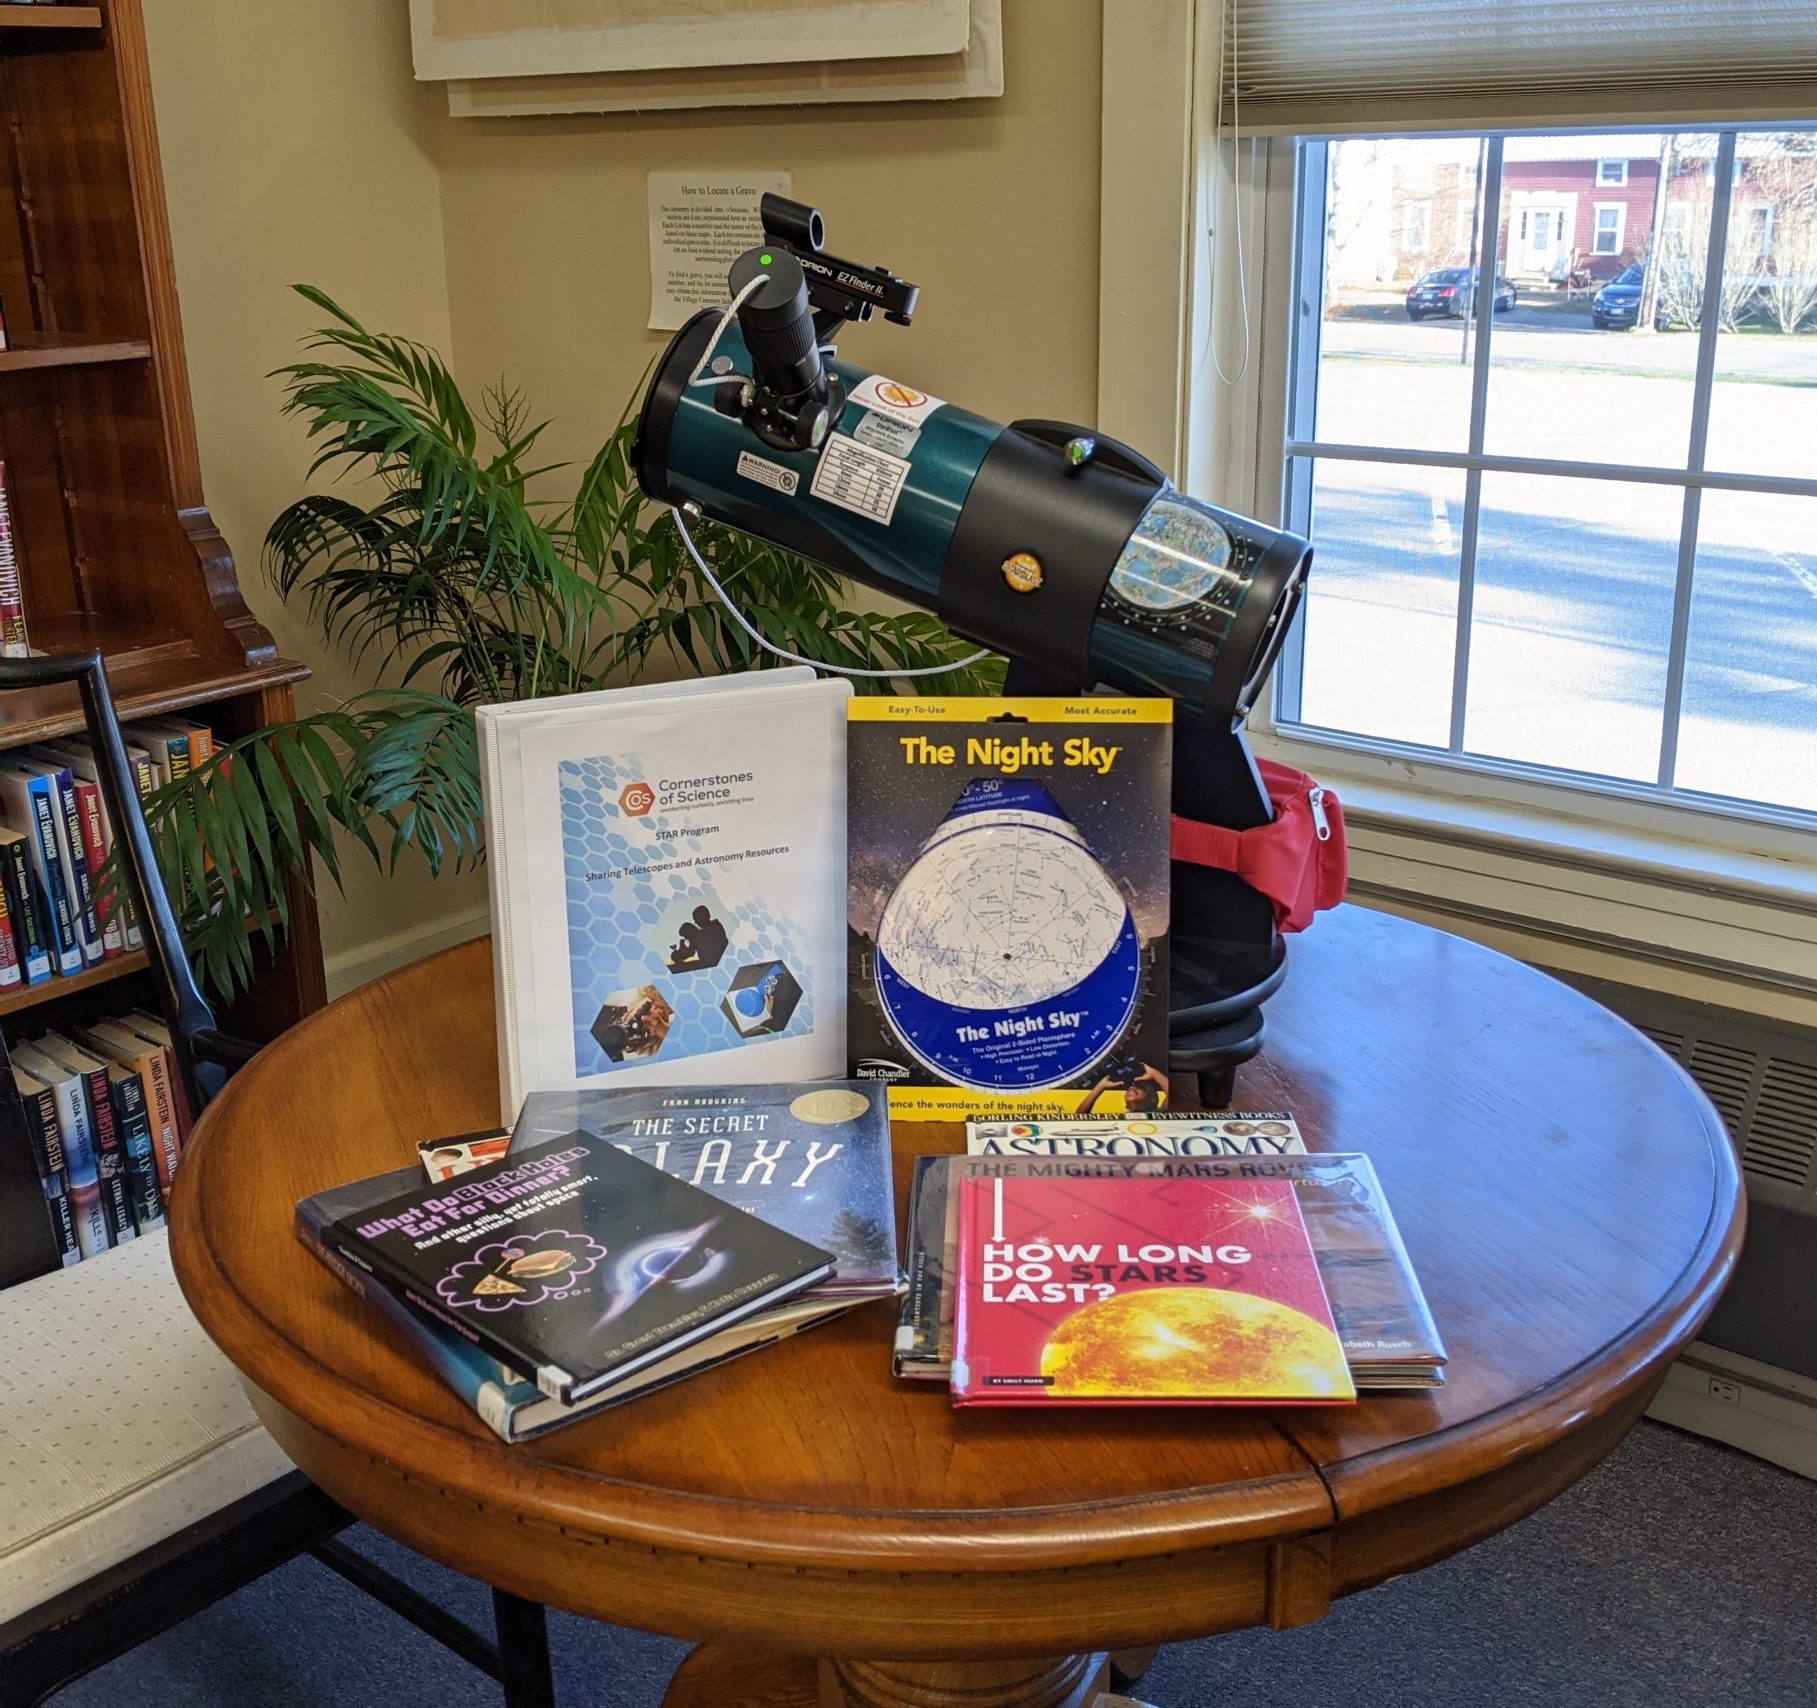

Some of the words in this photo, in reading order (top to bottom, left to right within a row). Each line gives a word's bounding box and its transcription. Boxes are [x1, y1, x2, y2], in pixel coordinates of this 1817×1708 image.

[681, 186, 697, 195] How
[699, 187, 706, 195] to
[707, 186, 729, 195] Locate
[736, 186, 757, 195] Grave
[800, 259, 833, 277] ORION
[837, 272, 848, 282] EZ
[849, 275, 875, 293] Finder
[880, 415, 913, 433] ORION
[748, 458, 780, 474] WARNING!
[0, 531, 20, 606] EVANOVICH
[888, 705, 946, 715] Easy-To-Use
[1064, 706, 1090, 716] Most
[1094, 706, 1137, 716] Accurate
[900, 736, 955, 765] The
[967, 737, 1054, 774] Night
[138, 762, 151, 794] JANET
[659, 771, 754, 792] Cornerstones
[62, 788, 76, 813] JANET
[86, 794, 97, 814] Janet
[659, 792, 675, 806] of
[677, 786, 731, 803] Science
[976, 792, 1002, 802] LATITUDE
[36, 798, 48, 822] JANET
[41, 820, 57, 860] EVANOVICH
[68, 812, 84, 861] EVANOVICH
[90, 813, 104, 848] Evanovich
[655, 830, 679, 841] STAR
[680, 824, 720, 839] Program
[14, 856, 24, 872] Janet
[585, 868, 622, 882] Sharing
[624, 861, 674, 877] Telescopes
[675, 858, 692, 870] and
[694, 851, 744, 866] Astronomy
[746, 846, 790, 858] Resources
[18, 872, 30, 900] Evanovich
[58, 900, 70, 926] CURIOUS
[956, 1025, 990, 1043] The
[994, 1016, 1044, 1038] Night
[972, 1046, 984, 1054] The
[985, 1042, 1010, 1054] Original
[1012, 1038, 1036, 1049] 2-Sided
[1037, 1032, 1076, 1046] Planisphere
[984, 1052, 998, 1060] High
[998, 1048, 1024, 1056] Precision
[1030, 1044, 1042, 1052] Low
[1043, 1040, 1070, 1050] Distortion
[149, 1055, 160, 1082] LINDA
[1000, 1056, 1013, 1065] Easy
[1020, 1054, 1034, 1062] Read
[1042, 1050, 1058, 1058] Night
[856, 1069, 876, 1077] David
[878, 1068, 910, 1078] Chandler
[963, 1067, 972, 1075] 10
[994, 1074, 1002, 1082] 11
[90, 1071, 109, 1102] LINDA
[38, 1091, 52, 1123] LINDA
[70, 1088, 81, 1118] LINDA
[153, 1080, 170, 1124] FAIRSTEIN
[916, 1100, 934, 1108] the
[936, 1100, 980, 1110] wonders
[984, 1100, 994, 1110] of
[996, 1101, 1014, 1110] the
[1016, 1100, 1044, 1114] night
[1046, 1102, 1066, 1114] sky.
[96, 1102, 118, 1152] FAIRSTEIN
[632, 1118, 674, 1136] THE
[684, 1114, 770, 1134] SECRET
[1037, 1113, 1120, 1121] KINDERSLEY
[1152, 1112, 1238, 1120] EYEWITNESS
[1240, 1112, 1286, 1120] BOOKS
[44, 1122, 66, 1173] FAIRSTEIN
[75, 1118, 90, 1165] FAIRSTEIN
[132, 1124, 151, 1174] LIKELY
[162, 1126, 175, 1155] NIGHT
[981, 1136, 1296, 1156] ASTRONOMY
[613, 1138, 844, 1188] LAXY
[966, 1162, 1018, 1178] THE
[1027, 1161, 1136, 1178] MIGHTY
[1149, 1162, 1230, 1178] MARS
[112, 1179, 124, 1206] LETHAL
[356, 1206, 423, 1239] What
[422, 1196, 461, 1214] Do
[453, 1170, 526, 1202] Black
[521, 1147, 590, 1180] Holes
[400, 1214, 448, 1238] Eat
[445, 1198, 486, 1220] For
[484, 1166, 571, 1205] Dinner?
[58, 1196, 72, 1229] KILLER
[88, 1210, 102, 1238] KILLS
[116, 1204, 128, 1231] LEGACY
[414, 1236, 442, 1250] And
[441, 1222, 474, 1241] other
[474, 1210, 505, 1228] silly,
[503, 1203, 524, 1217] yet
[522, 1187, 562, 1209] totally
[561, 1175, 598, 1194] smart,
[456, 1216, 513, 1244] questions
[512, 1204, 546, 1220] about
[546, 1192, 580, 1208] space
[64, 1227, 76, 1252] HEA
[983, 1244, 1104, 1262] HOW
[1117, 1244, 1252, 1264] LONG
[983, 1263, 1053, 1282] DO
[1070, 1264, 1208, 1283] STARS
[983, 1282, 1116, 1303] LAST?
[1344, 1340, 1374, 1348] abeth
[1377, 1340, 1411, 1348] Rusch
